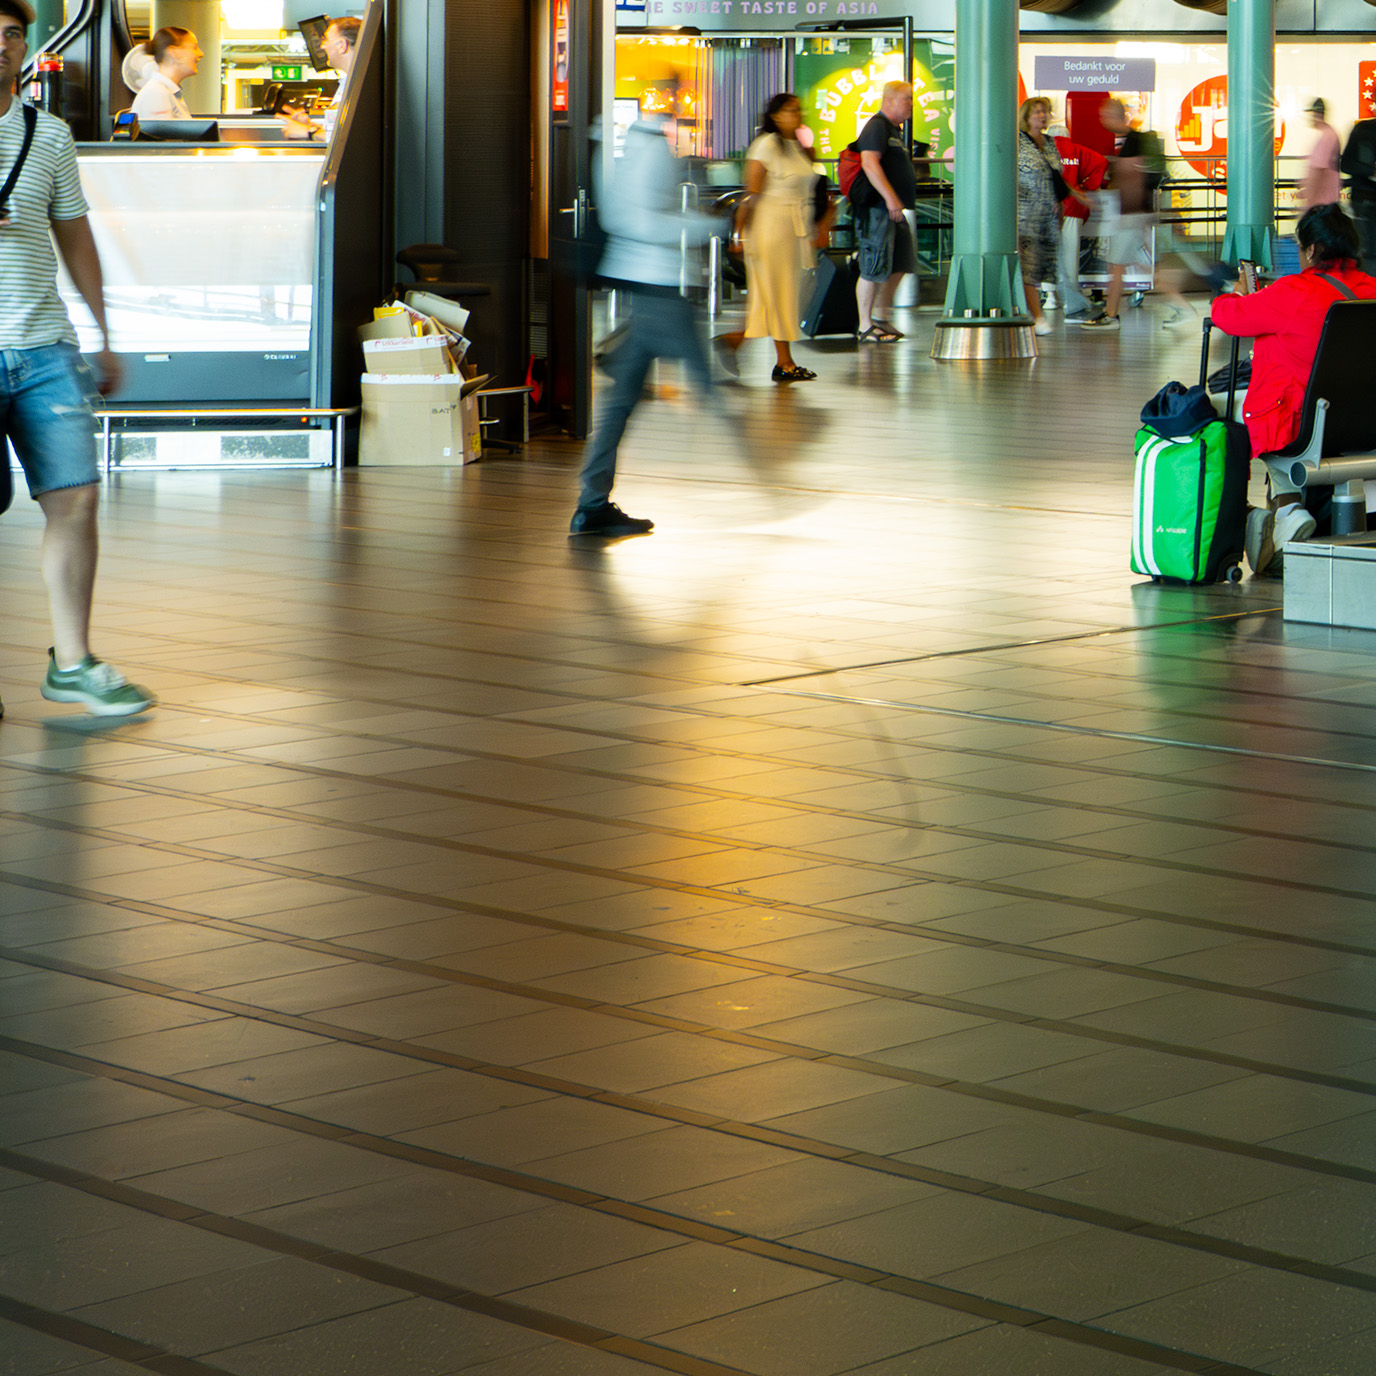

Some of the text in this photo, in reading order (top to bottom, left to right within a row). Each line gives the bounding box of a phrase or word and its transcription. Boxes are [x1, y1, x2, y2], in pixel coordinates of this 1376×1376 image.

[672, 2, 732, 14] SWEET
[741, 2, 797, 14] TASTE
[806, 2, 828, 14] OF
[837, 2, 879, 14] ASIA
[1064, 61, 1126, 72] Bedankt voor
[1068, 74, 1119, 86] uw geduld
[819, 128, 832, 154] THE
